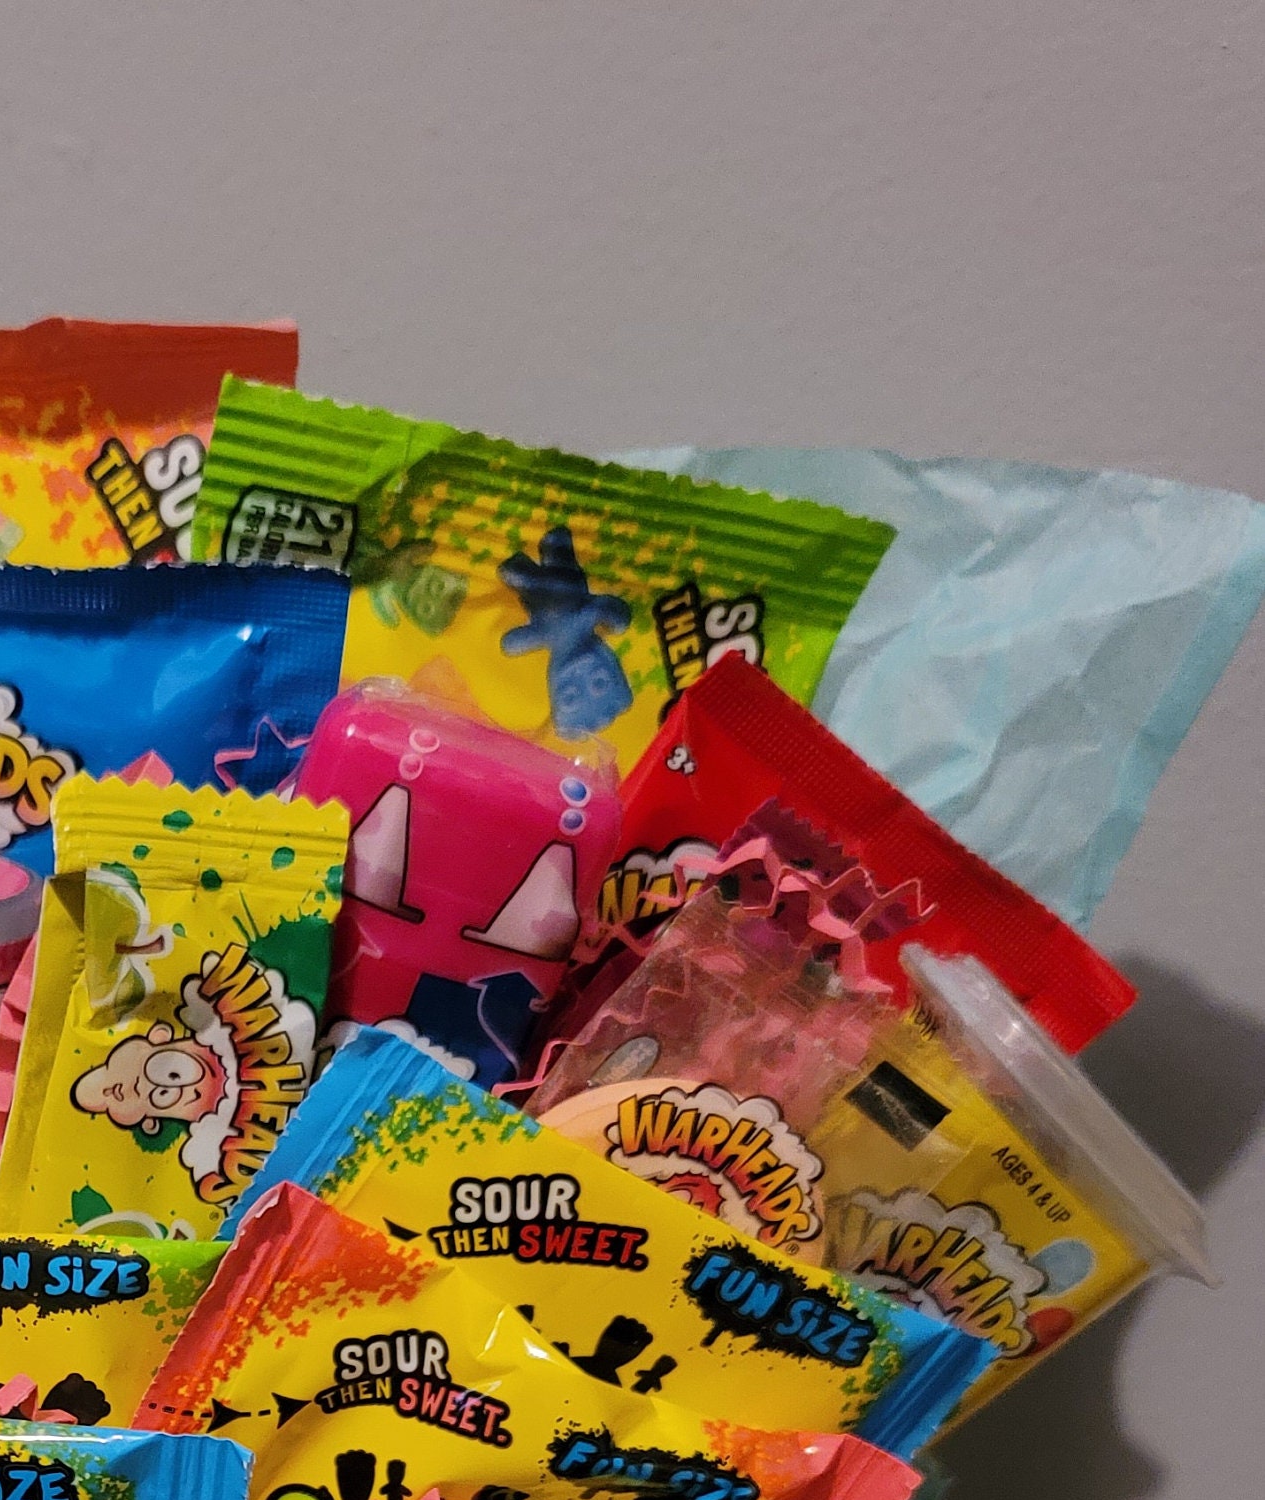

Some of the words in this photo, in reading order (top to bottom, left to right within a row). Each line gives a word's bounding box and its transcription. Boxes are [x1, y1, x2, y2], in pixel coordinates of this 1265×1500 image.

[91, 446, 163, 551] THEN
[197, 942, 307, 1206] WARHEADS
[615, 1094, 817, 1252] WARHEADS
[991, 1145, 1035, 1187] AGES
[454, 1178, 578, 1225] SOUR
[1027, 1183, 1044, 1198] 4
[1037, 1191, 1054, 1210] &
[1044, 1201, 1072, 1226] UP
[433, 1226, 511, 1255] THEN
[518, 1225, 649, 1267] SWEET.
[692, 1253, 779, 1312] FUN
[339, 1336, 448, 1380] SOUR
[319, 1377, 393, 1407] THEN
[399, 1377, 512, 1445] SWEET.
